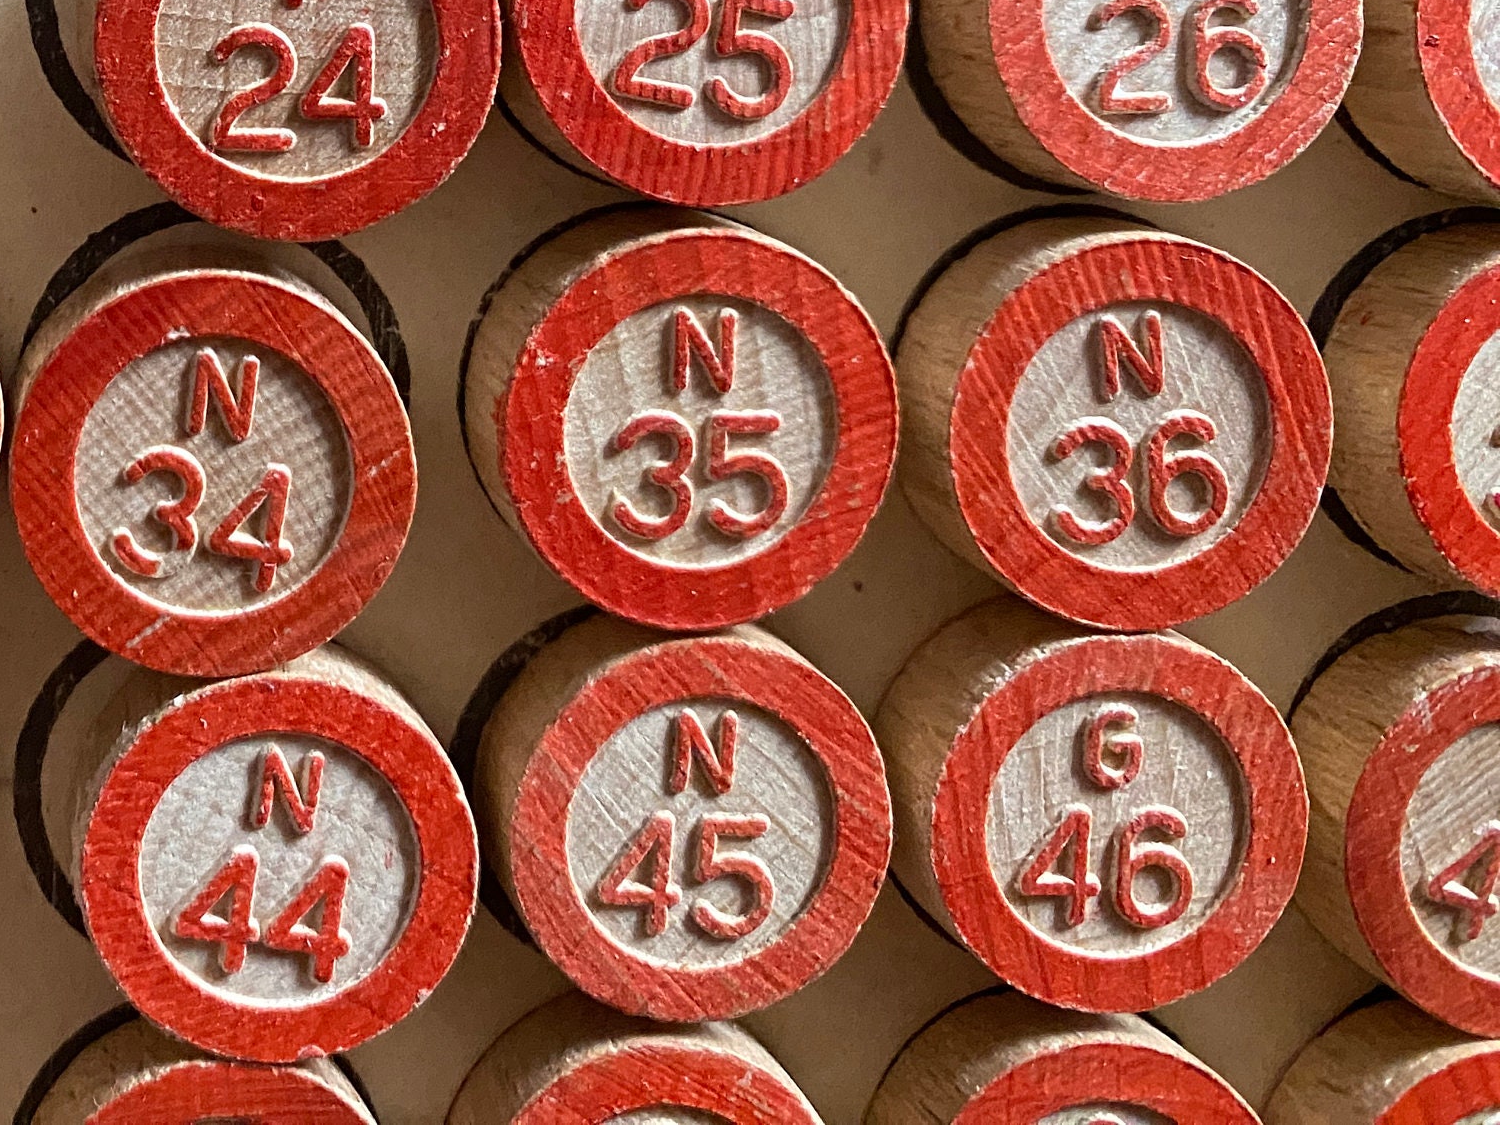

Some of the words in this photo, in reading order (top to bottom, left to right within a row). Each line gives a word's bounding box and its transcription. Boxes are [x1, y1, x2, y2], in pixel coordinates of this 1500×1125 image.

[212, 21, 386, 152] 24
[187, 347, 260, 443] N
[672, 307, 740, 393] N
[1097, 309, 1165, 402] N
[110, 444, 295, 592] 34
[612, 408, 789, 540] 35
[1053, 408, 1228, 545] 36
[250, 743, 325, 835] N
[670, 707, 740, 795] N
[1084, 703, 1143, 789] G
[171, 843, 352, 984] 44
[601, 810, 774, 939] 45
[1020, 803, 1192, 928] 46
